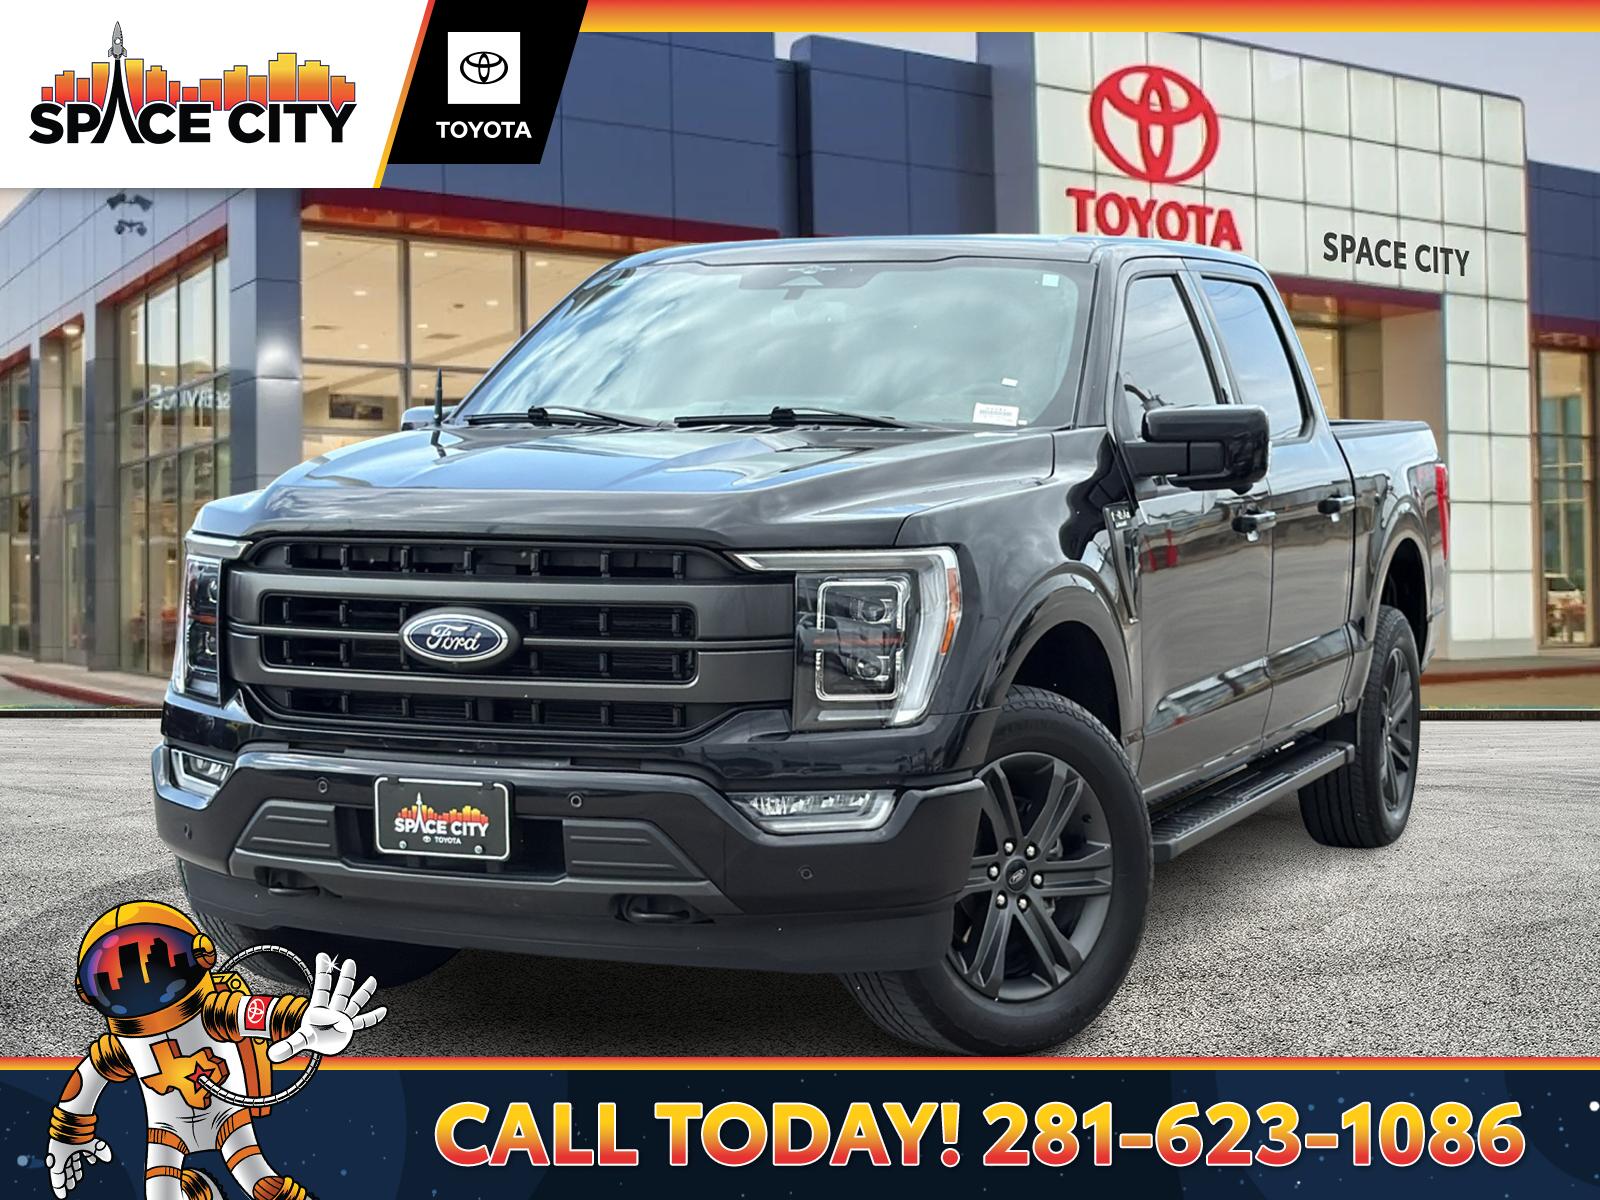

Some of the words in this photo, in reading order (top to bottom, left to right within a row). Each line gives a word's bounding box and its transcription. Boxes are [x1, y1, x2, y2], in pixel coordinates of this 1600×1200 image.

[1066, 188, 1242, 251] TOYOTA
[1322, 231, 1407, 270] SPACE
[1414, 244, 1471, 277] CITY
[426, 624, 482, 651] Ford
[394, 805, 448, 835] SPACE
[451, 821, 489, 837] CITY
[435, 836, 462, 845] TOYOTA
